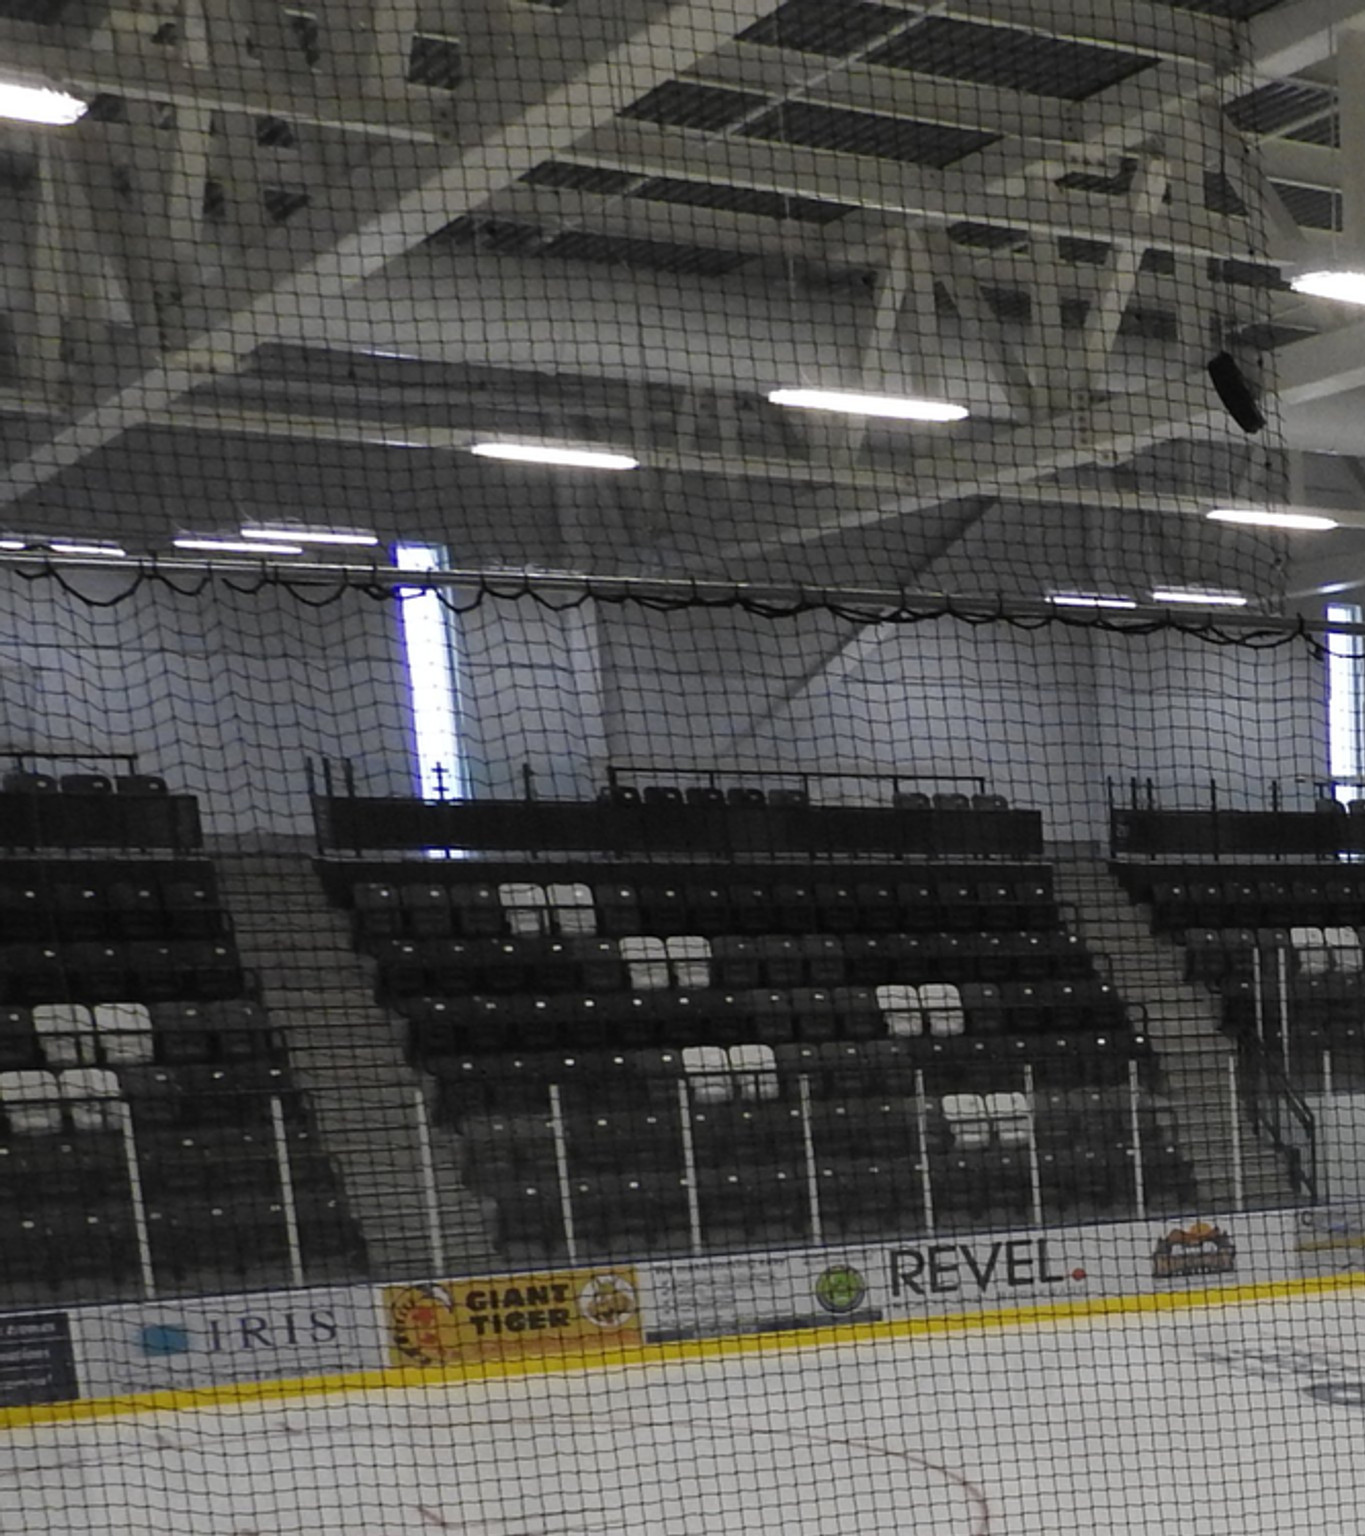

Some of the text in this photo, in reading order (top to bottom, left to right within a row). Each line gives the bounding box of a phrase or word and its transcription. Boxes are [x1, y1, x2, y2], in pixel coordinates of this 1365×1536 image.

[465, 1283, 569, 1312] GIANT
[208, 1310, 337, 1351] IRIS
[470, 1308, 570, 1335] TIGER
